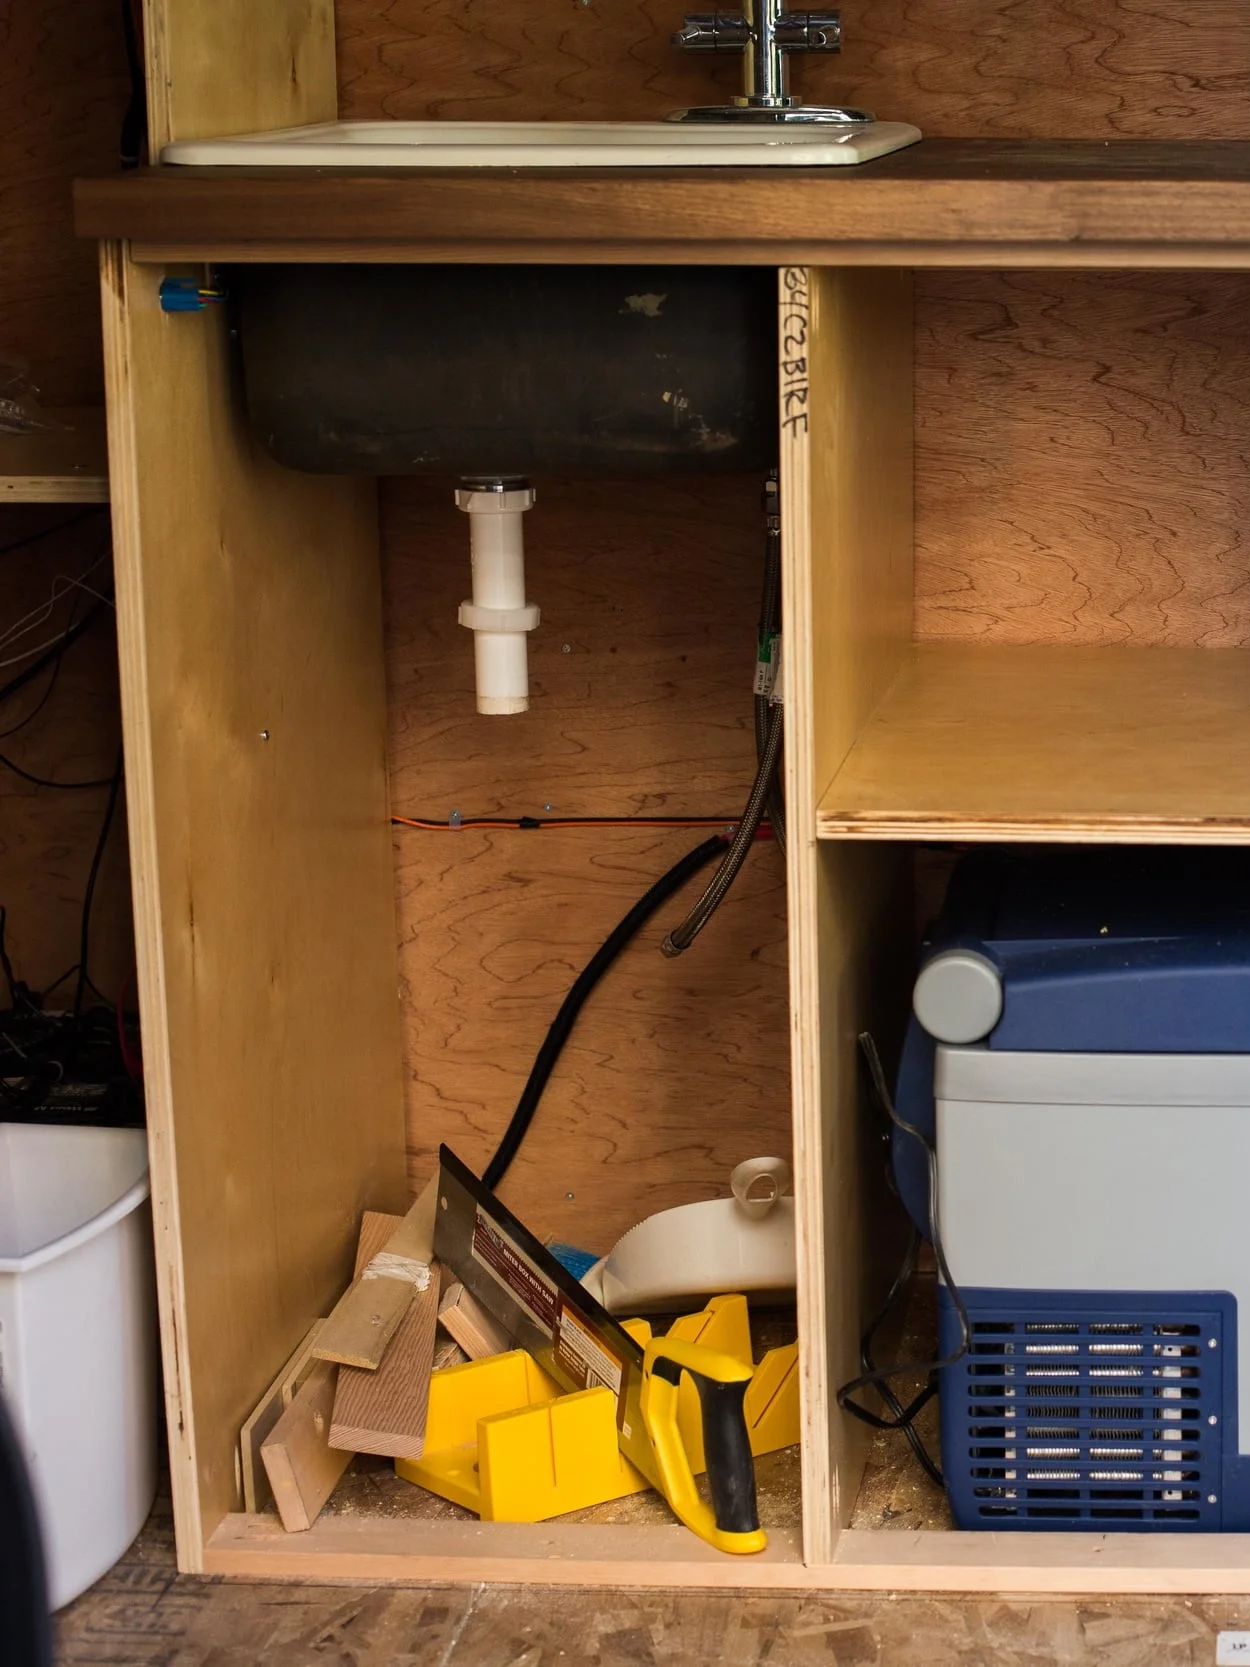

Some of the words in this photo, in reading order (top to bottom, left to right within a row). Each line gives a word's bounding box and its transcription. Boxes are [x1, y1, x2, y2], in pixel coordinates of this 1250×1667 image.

[503, 1248, 519, 1269] MITER
[518, 1264, 530, 1279] BOX
[529, 1276, 542, 1293] WITH
[541, 1288, 554, 1305] SAW
